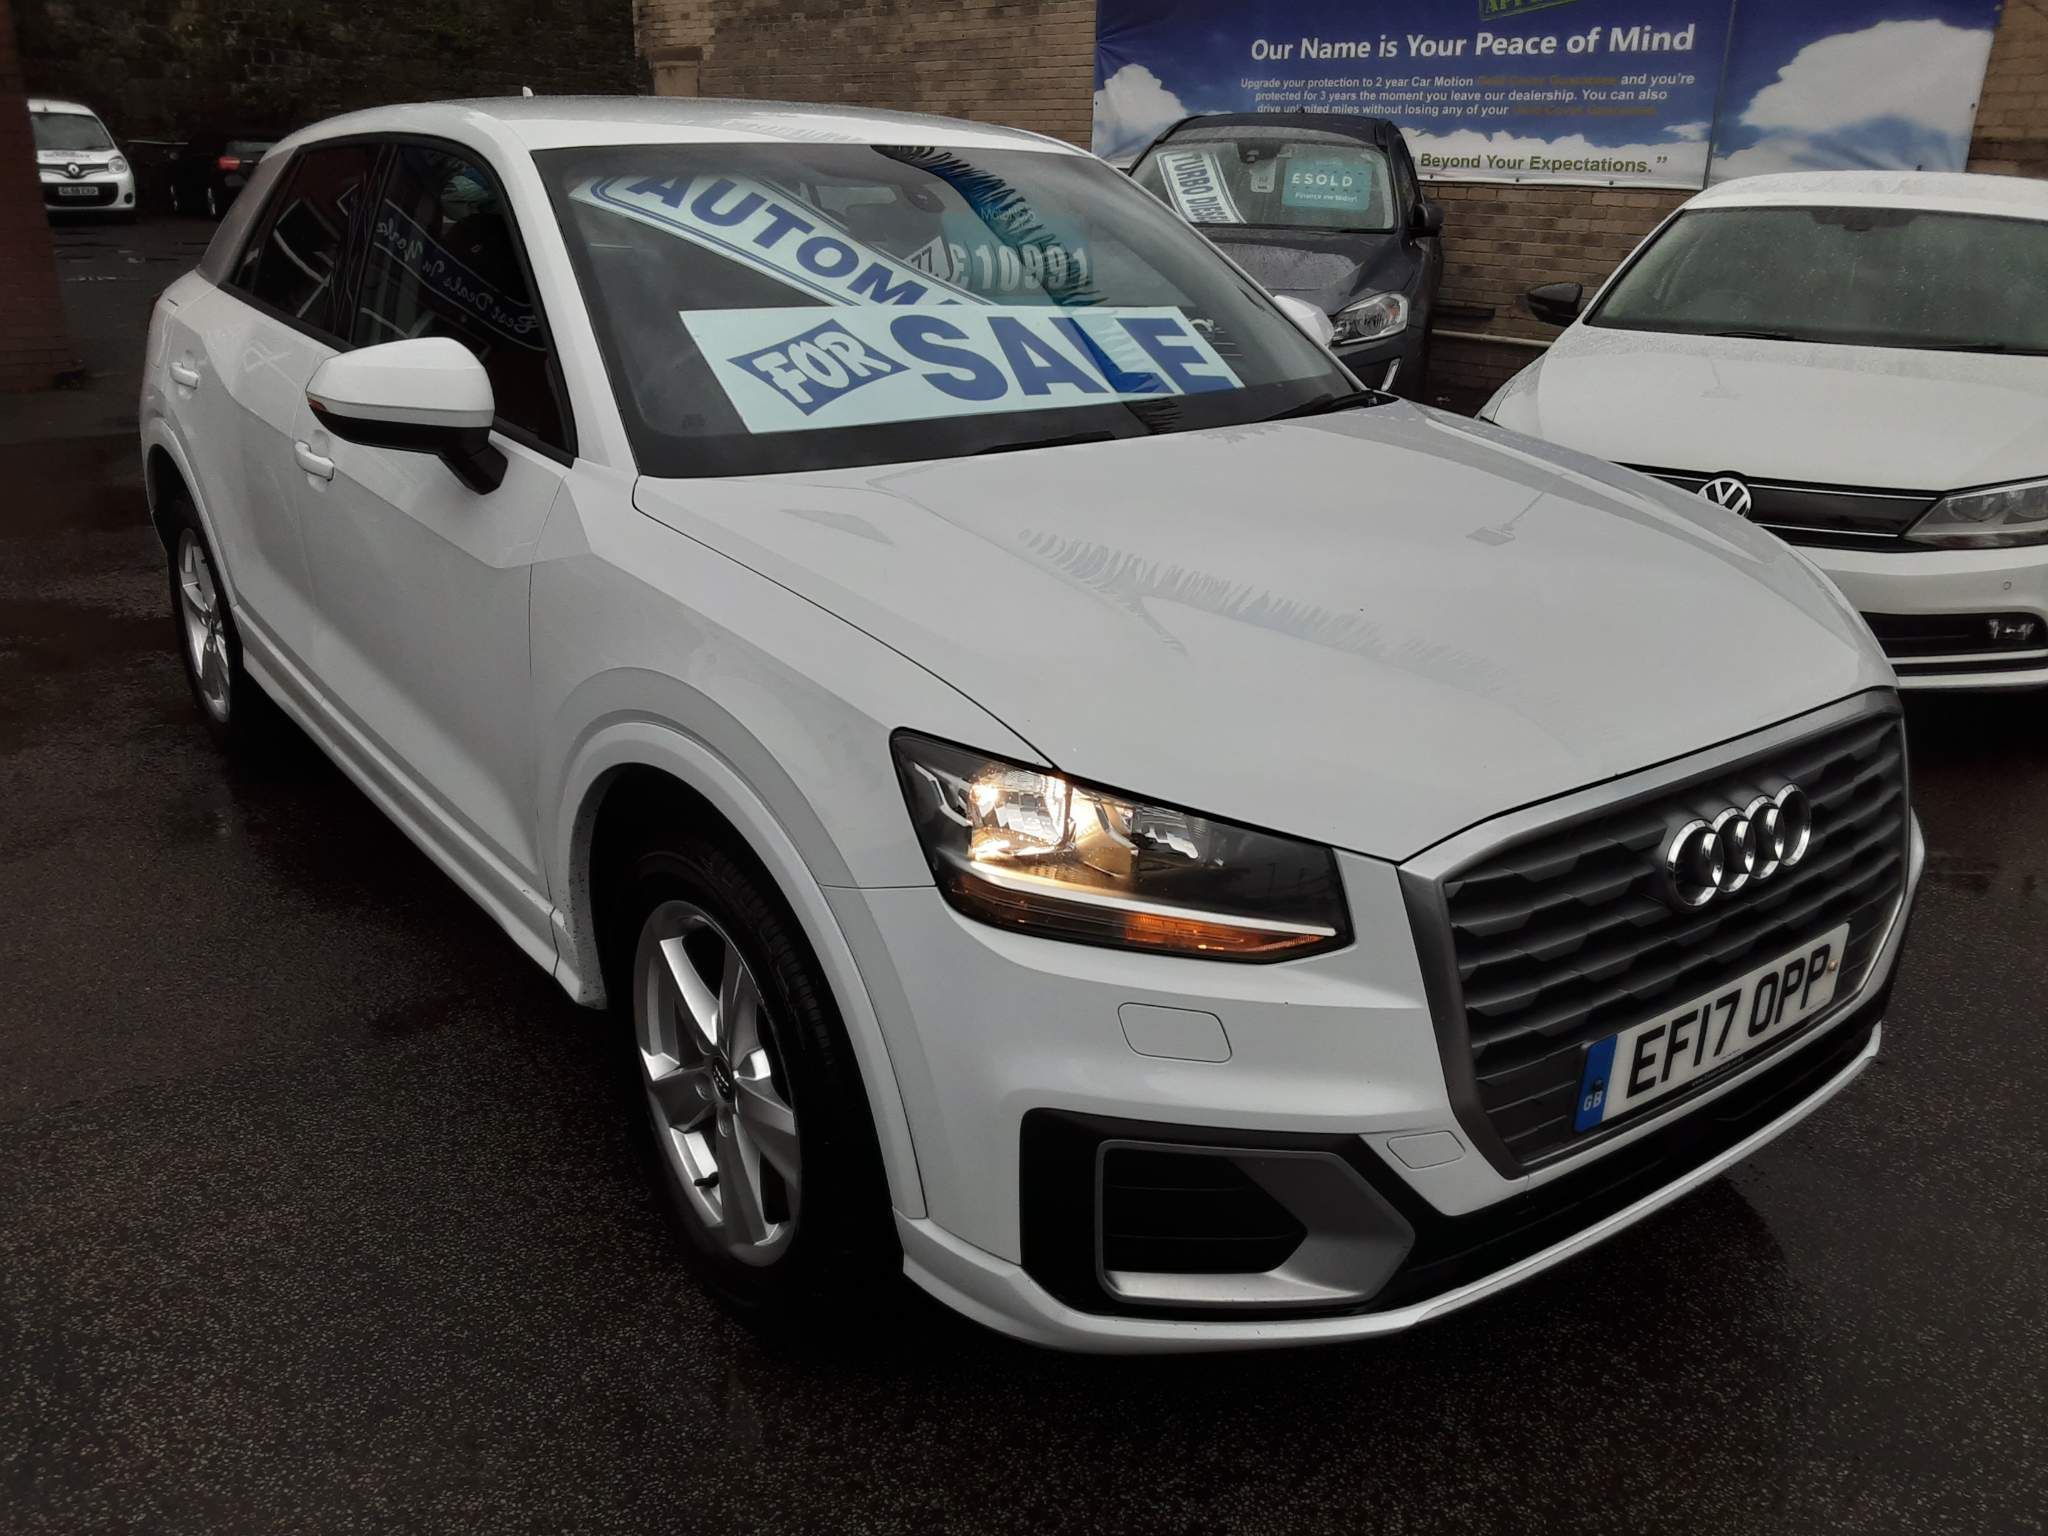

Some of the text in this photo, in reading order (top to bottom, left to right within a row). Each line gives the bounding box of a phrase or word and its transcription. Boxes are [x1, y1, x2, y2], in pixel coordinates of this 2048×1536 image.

[1251, 24, 1696, 60] Our Name is Your Peace of Mind
[1240, 77, 1280, 90] Upgrade
[1283, 79, 1306, 91] your
[1307, 77, 1359, 90] protection
[1362, 77, 1373, 88] to
[1375, 76, 1383, 87] 2
[1385, 78, 1409, 90] year
[1411, 76, 1430, 88] Car
[1433, 76, 1473, 88] Motion
[1621, 73, 1646, 85] and
[1650, 73, 1695, 87] you're
[1255, 89, 1668, 103] protected for 3 years the moment you leave our dealership. You can also
[1257, 104, 1281, 113] drive
[1332, 104, 1359, 114] miles
[1362, 103, 1402, 114] without
[1405, 104, 1439, 117] losing
[1442, 106, 1463, 117] any
[1466, 104, 1479, 115] of
[1481, 105, 1509, 118] your
[1172, 152, 1213, 195] TURBO
[1421, 153, 1481, 171] Beyond
[1486, 154, 1525, 170] Your
[628, 177, 963, 306] AUTOM
[755, 315, 1230, 400] FOR SALE
[1627, 988, 1742, 1099] EF17
[1583, 1090, 1604, 1111] GB
